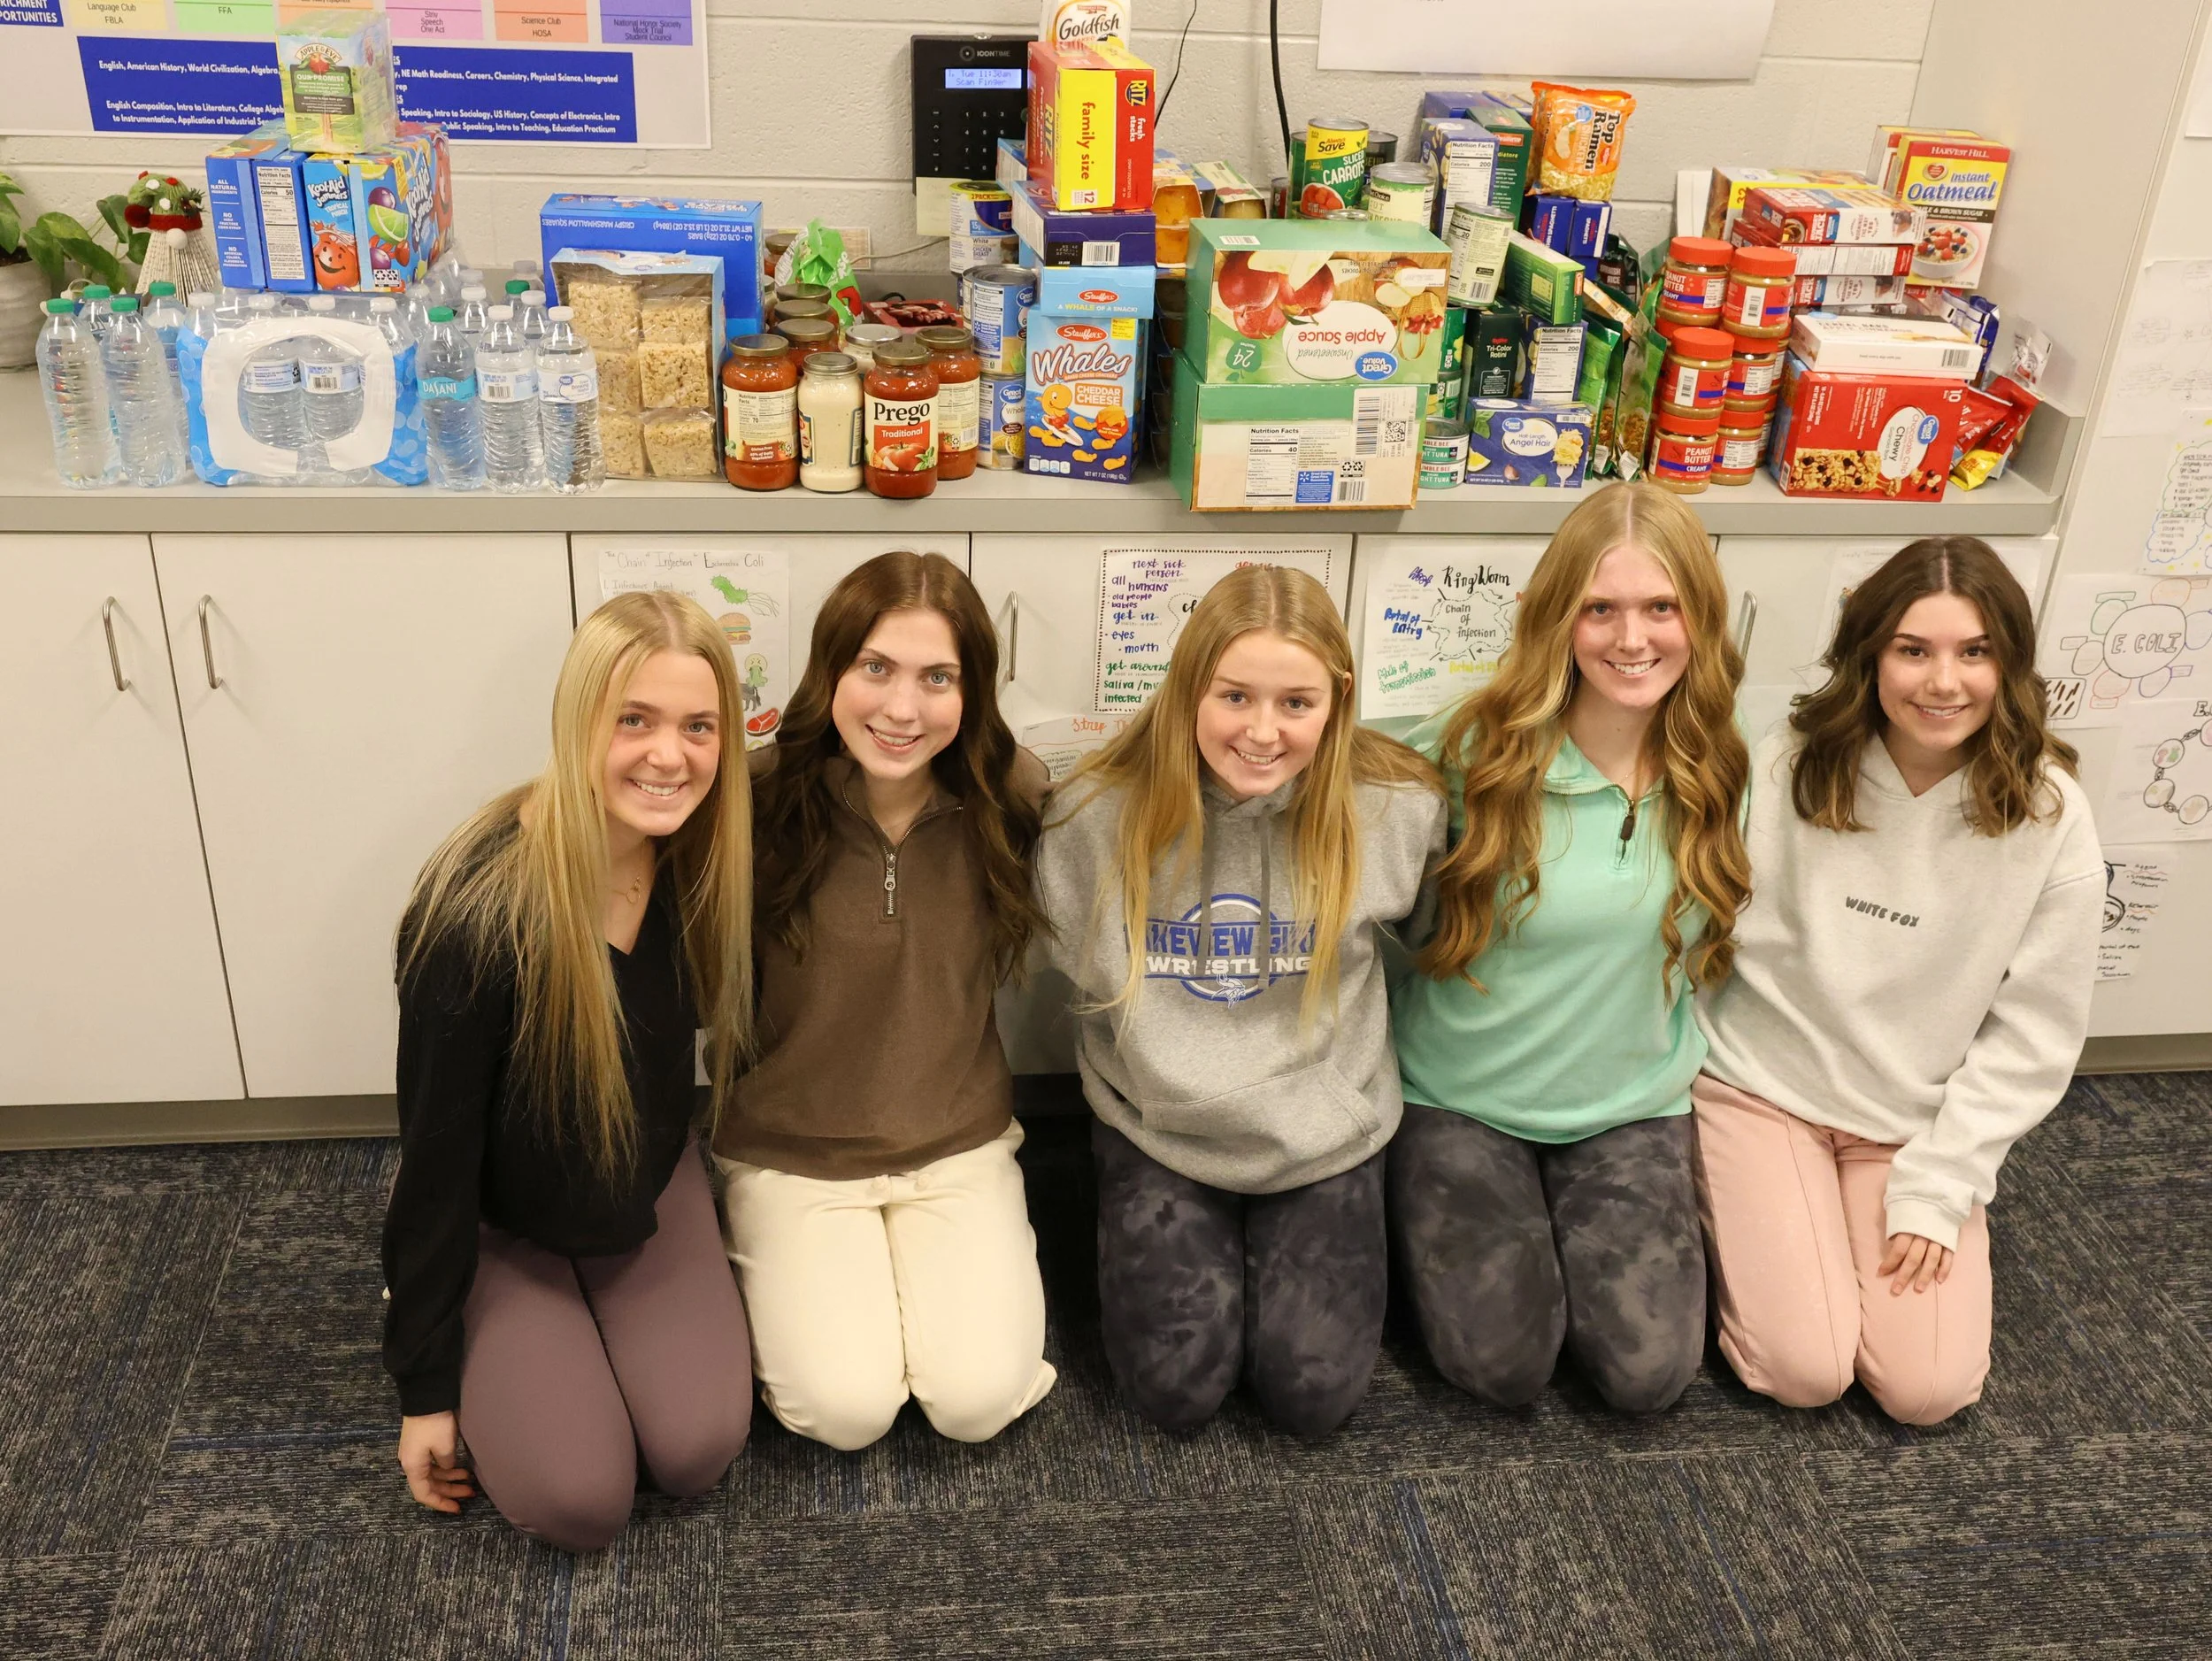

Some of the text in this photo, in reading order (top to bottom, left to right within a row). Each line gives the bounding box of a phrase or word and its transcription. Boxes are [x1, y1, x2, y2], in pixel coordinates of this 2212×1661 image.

[88, 2, 136, 12] Language Club
[105, 16, 124, 25] FBLA
[421, 19, 443, 27] Speech
[521, 16, 544, 25] Science
[659, 20, 681, 29] Society
[1059, 13, 1120, 40] Goldfish
[625, 32, 672, 42] Student Council
[301, 45, 337, 61] APPLE EVE
[99, 60, 280, 76] English, American History, World Civilization, Algebra,
[401, 69, 618, 85] NE Math Readiness, Careers, Chemistry, Physical Science, Integrated
[1130, 80, 1148, 107] RITZ
[106, 100, 264, 114] English Composition, Intro Literature, College
[120, 115, 256, 127] Instrumentation, Application Industrial
[401, 108, 620, 122] Speaking, Intro Sociology, US History, Concepts Electronics, Intro
[462, 122, 617, 135] Speaking, Intro Teaching, Education Practicum
[1137, 117, 1147, 140] fresh
[1602, 112, 1621, 144] Top
[1076, 102, 1096, 180] family size
[1318, 141, 1346, 152] Save
[1585, 111, 1608, 171] Ramen
[1343, 150, 1364, 165] SLICED
[1931, 146, 1990, 158] HARVEST HILL
[1323, 160, 1365, 186] CARROTS
[1950, 173, 1991, 182] Instant
[307, 176, 346, 197] Kool-Aid
[1907, 181, 1998, 202] Oatmeal
[1084, 190, 1095, 204] 12
[541, 219, 567, 227] SQUARES
[568, 219, 612, 228] MARSHMALLOW
[1816, 212, 1827, 242] JACK
[1297, 330, 1386, 345] Apple Sauce
[1295, 346, 1353, 361] Unsweetened
[1486, 344, 1512, 353] Tri-Color
[1033, 344, 1132, 385] Whales
[1233, 348, 1255, 367] 24
[1361, 357, 1386, 365] Value
[1362, 365, 1392, 375] Great
[422, 381, 457, 396] DASANI
[1076, 385, 1122, 396] CHEDDAR
[1076, 394, 1121, 405] CHEESE
[873, 402, 930, 427] Prego
[881, 426, 924, 438] Traditional
[1510, 438, 1533, 449] Angel
[1888, 427, 1906, 462] Chewy
[1686, 446, 1713, 456] PEANUT
[1685, 455, 1711, 465] BUTTER
[617, 550, 647, 569] Chain
[655, 550, 694, 571] Infection
[744, 551, 765, 569] Coli
[1133, 558, 1186, 569] next sick
[1111, 575, 1125, 586] all
[1146, 569, 1184, 578] person
[1128, 582, 1169, 592] humans
[1383, 607, 1409, 623] Portal
[1445, 604, 1472, 615] Chain
[1113, 610, 1135, 625] get
[1111, 630, 1135, 642] eyes
[1391, 622, 1424, 641] Entry
[1456, 626, 1497, 642] infection
[2110, 632, 2183, 654] E. COLI
[1105, 659, 1127, 675] get
[1103, 680, 1134, 688] saliva
[1104, 694, 1142, 704] infected
[1845, 896, 1920, 927] WHITE FOX
